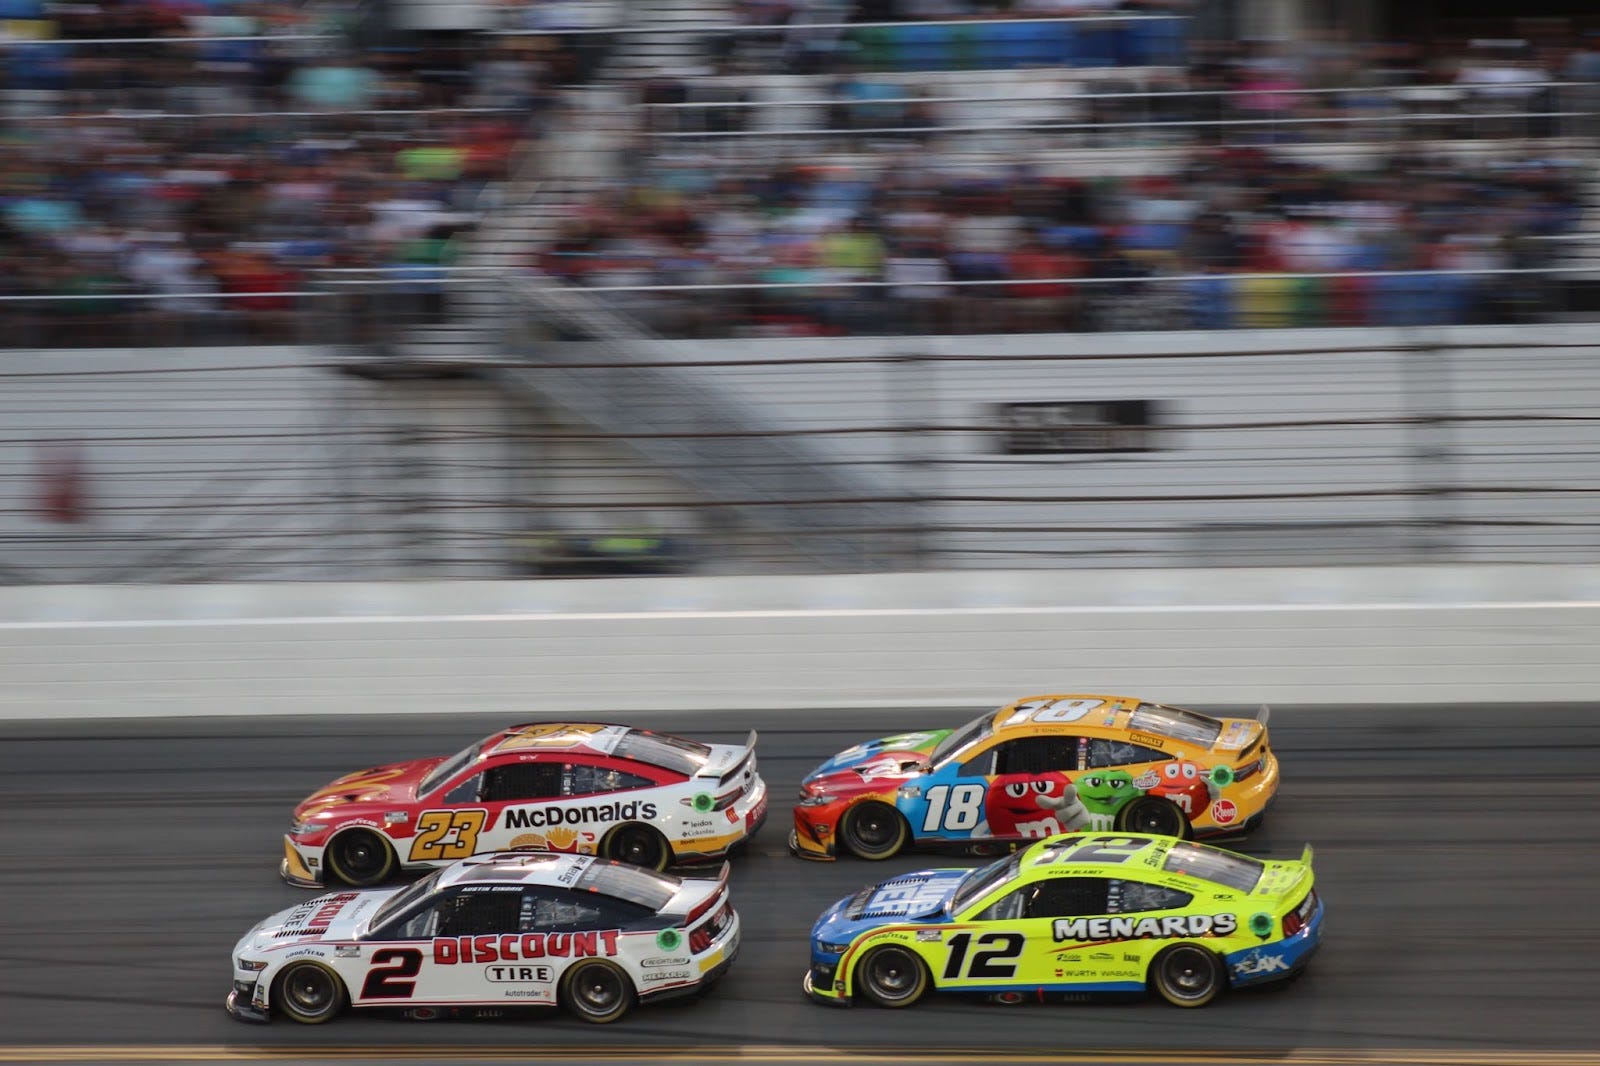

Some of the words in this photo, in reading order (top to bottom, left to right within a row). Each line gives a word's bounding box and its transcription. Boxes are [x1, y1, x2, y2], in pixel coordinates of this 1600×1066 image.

[1002, 698, 1107, 726] 18
[505, 800, 658, 829] McDonald's
[922, 783, 985, 832] 18
[407, 808, 486, 862] 23
[1034, 837, 1154, 864] 12
[1053, 912, 1238, 943] MENARDS
[432, 929, 621, 965] DISCOUNT
[942, 932, 1026, 981] 12
[359, 946, 424, 1000] 2
[491, 967, 548, 982] TIRE
[504, 989, 542, 998] Autotrader
